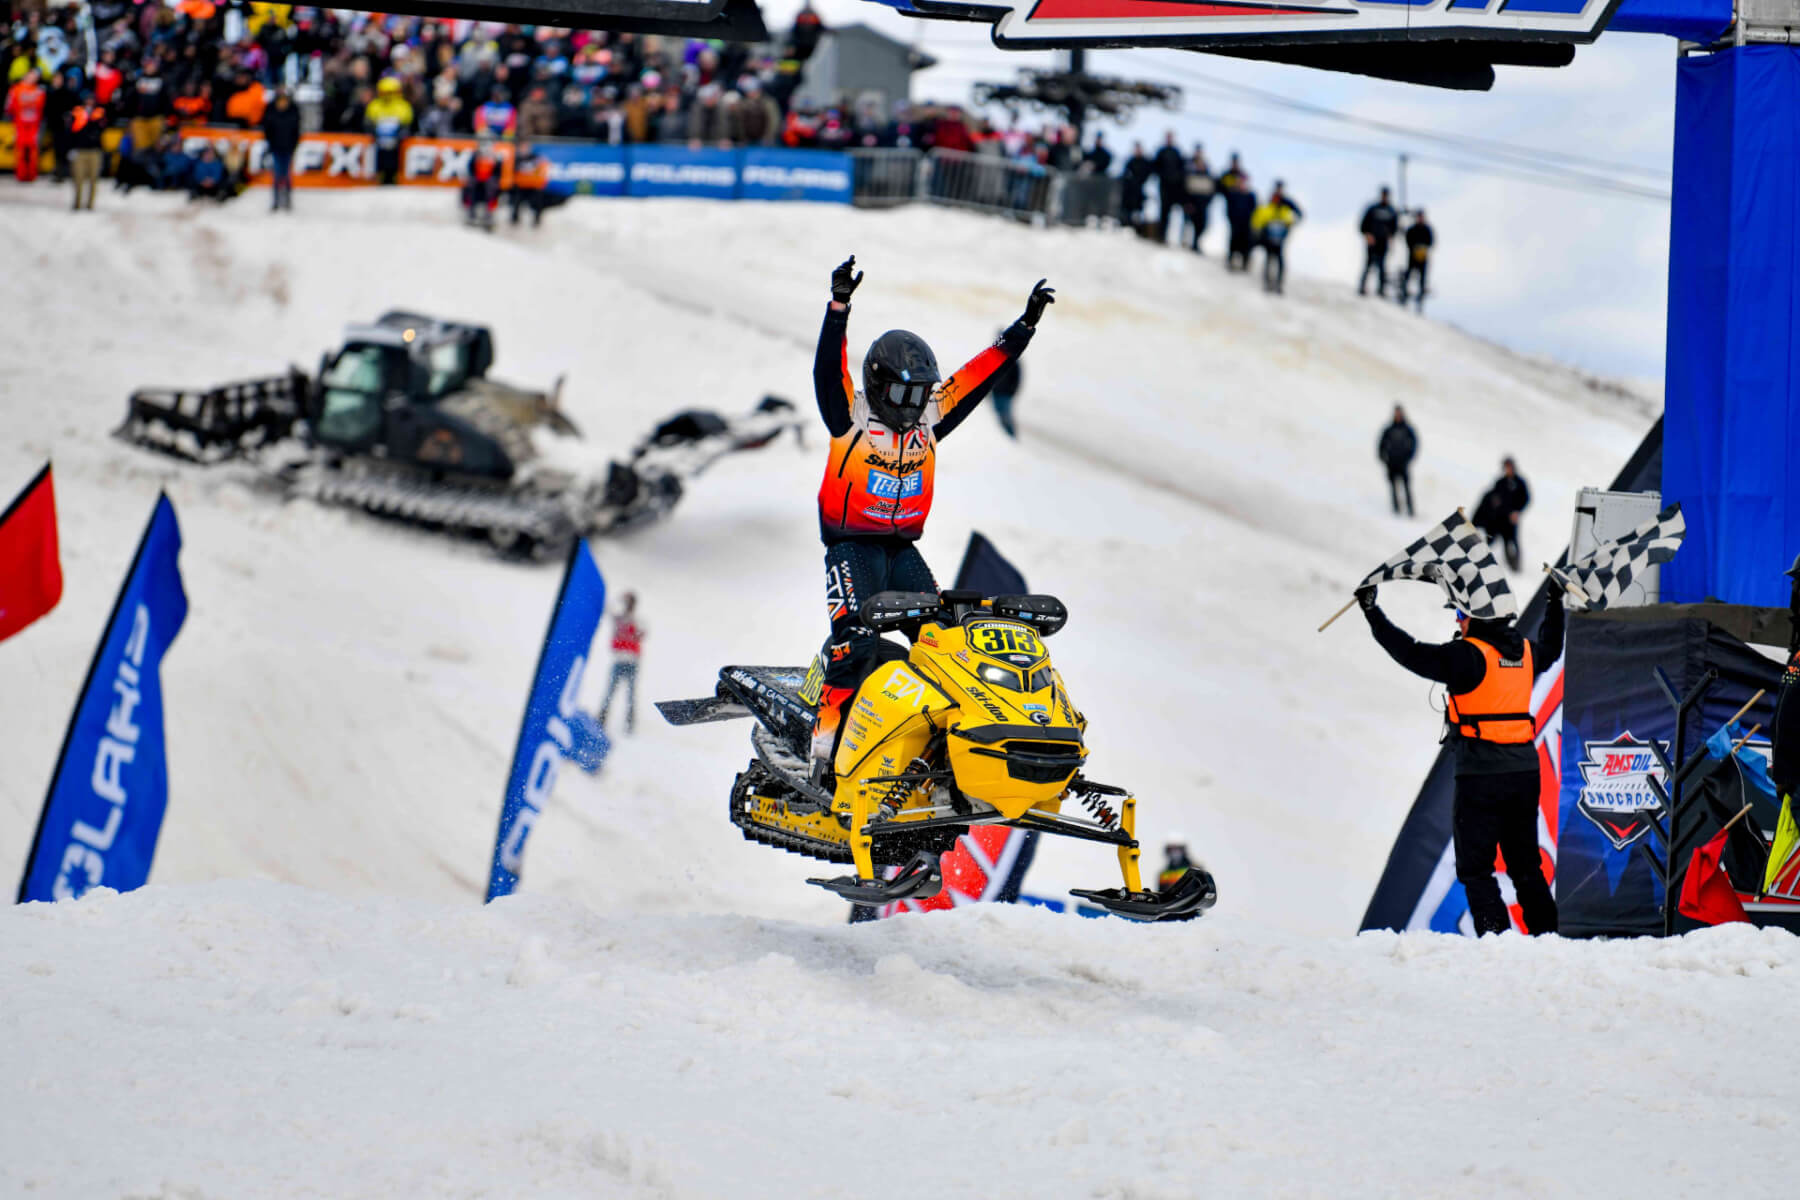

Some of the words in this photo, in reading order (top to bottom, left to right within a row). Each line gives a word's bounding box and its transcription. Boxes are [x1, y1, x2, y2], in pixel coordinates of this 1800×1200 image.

[631, 163, 736, 187] POLARIS
[742, 165, 849, 191] POLARIS
[982, 628, 1037, 653] 313
[52, 602, 151, 903] OLARIS
[1602, 753, 1652, 776] AMSOIL
[1586, 791, 1657, 807] SNOCROSS
